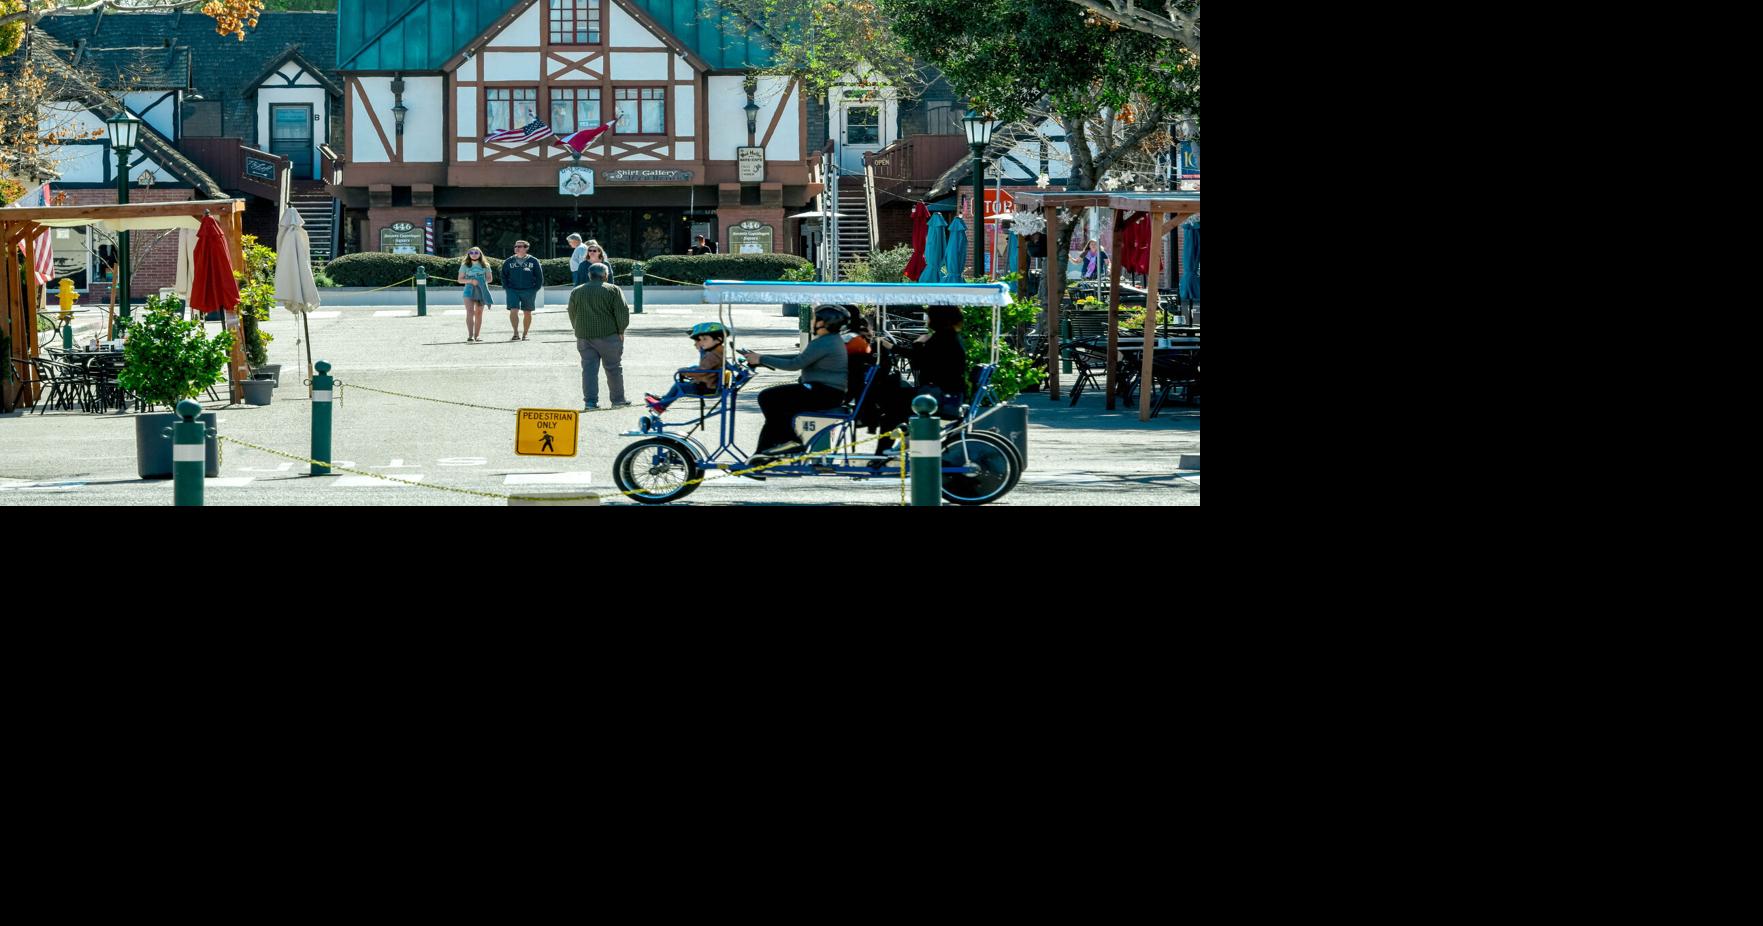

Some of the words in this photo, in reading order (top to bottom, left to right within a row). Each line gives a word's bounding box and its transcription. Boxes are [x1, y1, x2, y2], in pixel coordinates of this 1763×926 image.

[616, 169, 639, 179] Shirt
[642, 169, 677, 177] Gallery
[984, 200, 1013, 214] TOP
[523, 412, 572, 420] PEDESTRIAN
[537, 421, 557, 429] ONLY
[803, 421, 815, 431] 45
